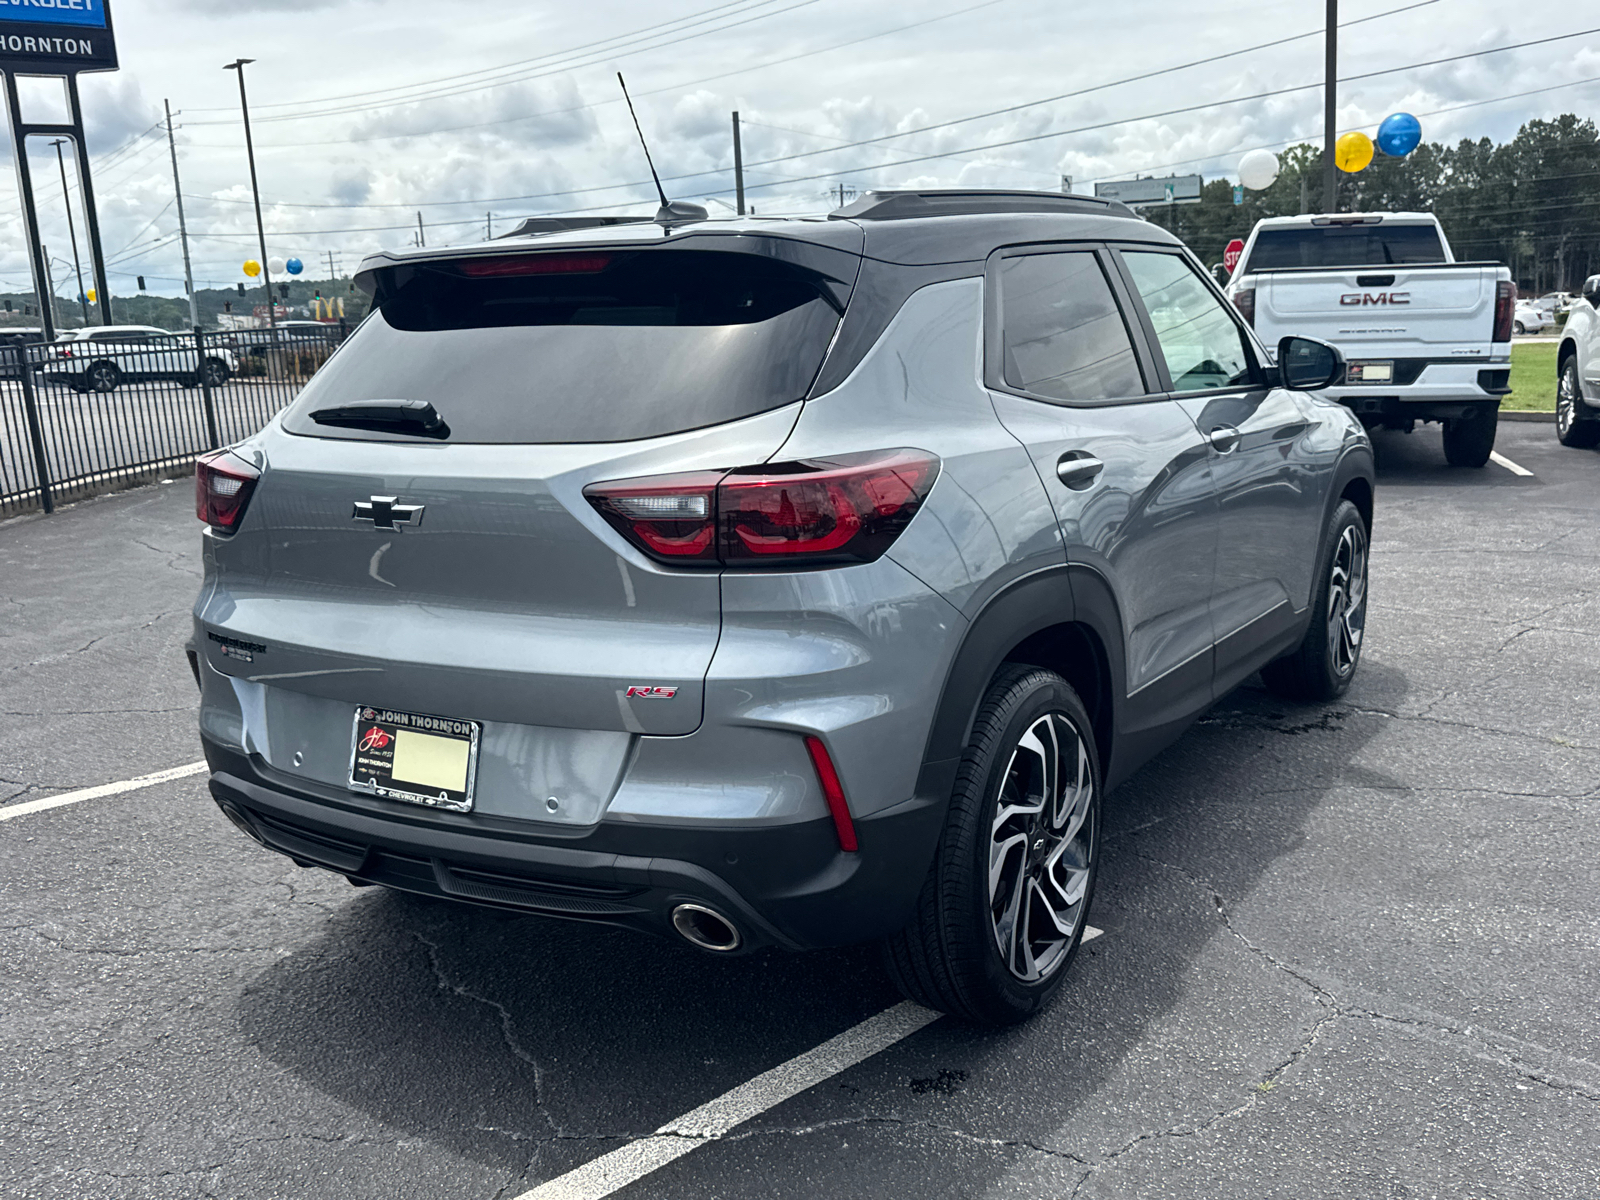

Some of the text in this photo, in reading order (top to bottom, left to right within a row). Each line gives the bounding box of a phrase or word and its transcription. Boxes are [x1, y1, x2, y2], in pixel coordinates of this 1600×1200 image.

[1226, 251, 1241, 266] ST
[1340, 292, 1410, 305] GMC
[625, 685, 679, 698] RS
[381, 710, 409, 724] JOHN
[411, 716, 471, 735] THORNTON
[388, 790, 424, 803] CHEVROLET
